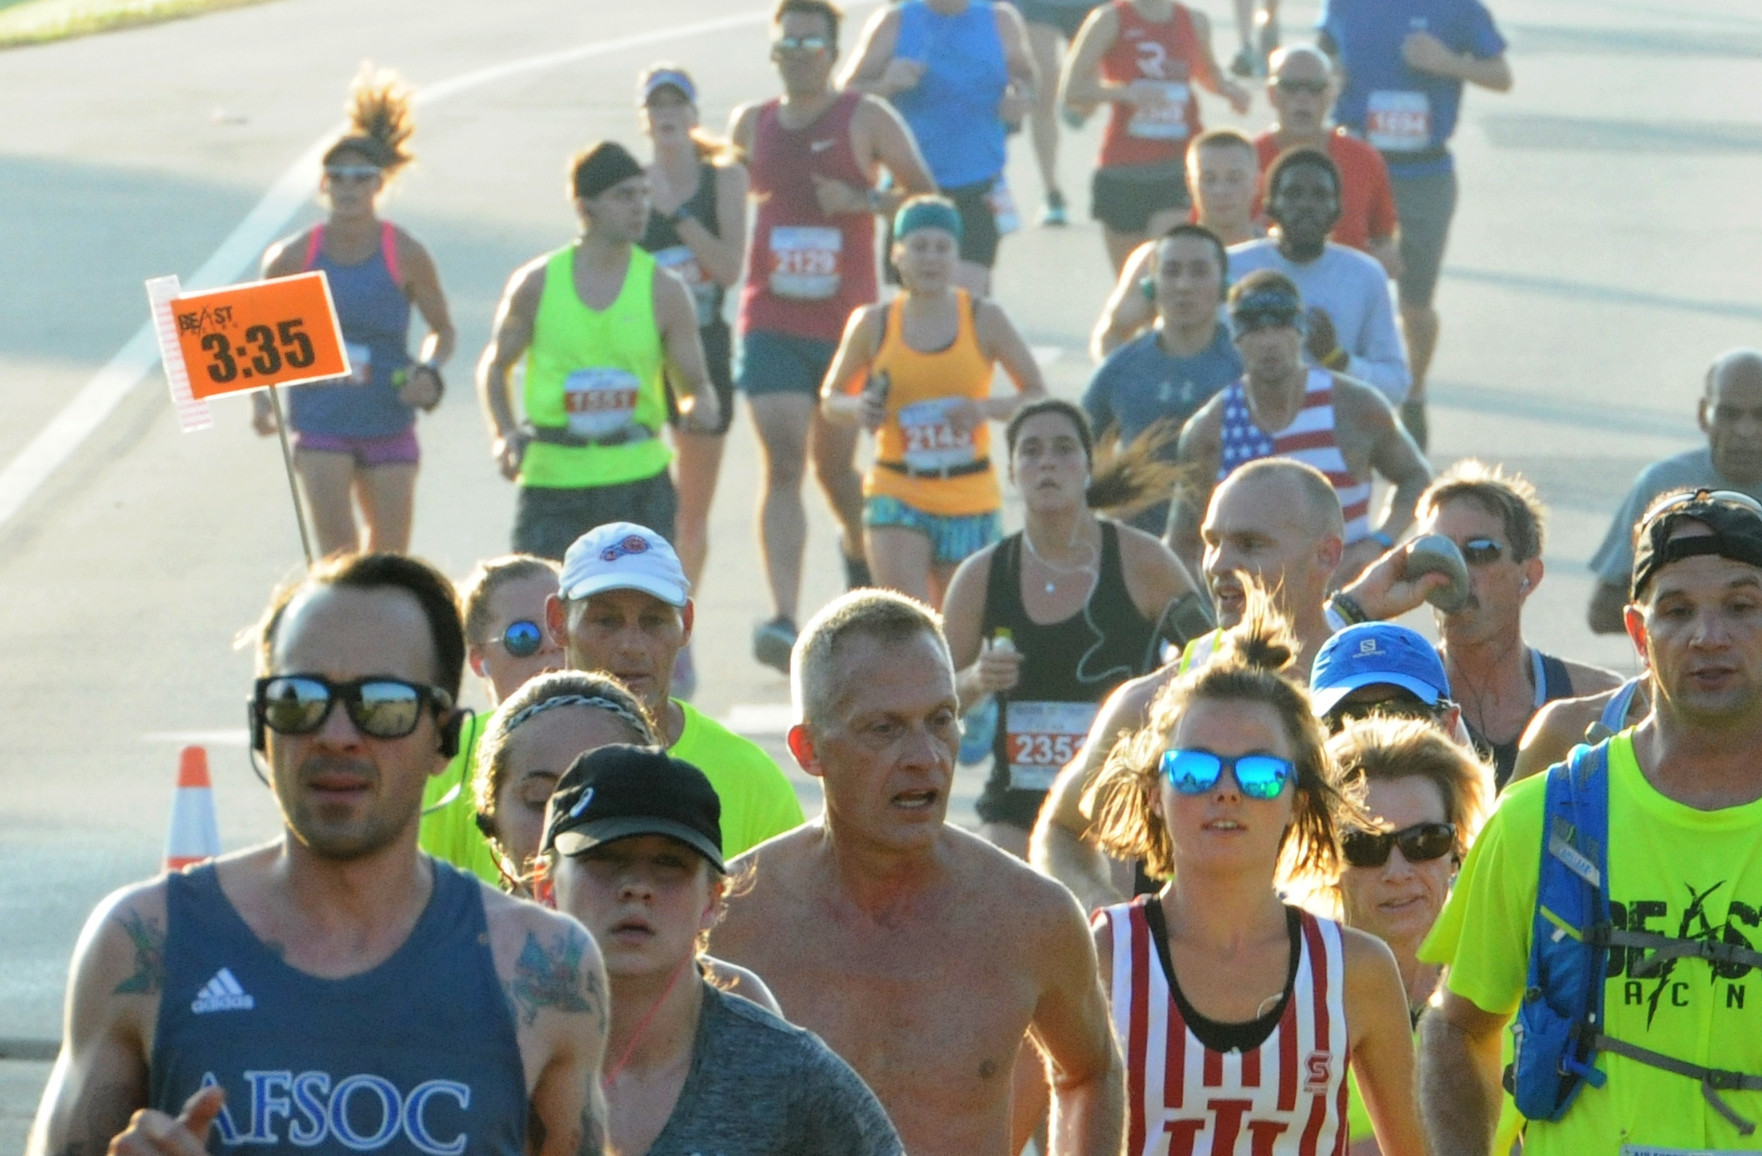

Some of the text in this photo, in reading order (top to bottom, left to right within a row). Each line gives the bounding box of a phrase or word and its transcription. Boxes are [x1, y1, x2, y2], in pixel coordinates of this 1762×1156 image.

[178, 304, 234, 332] BEAST
[202, 318, 316, 384] 3:35
[200, 1070, 471, 1156] AFSOC
